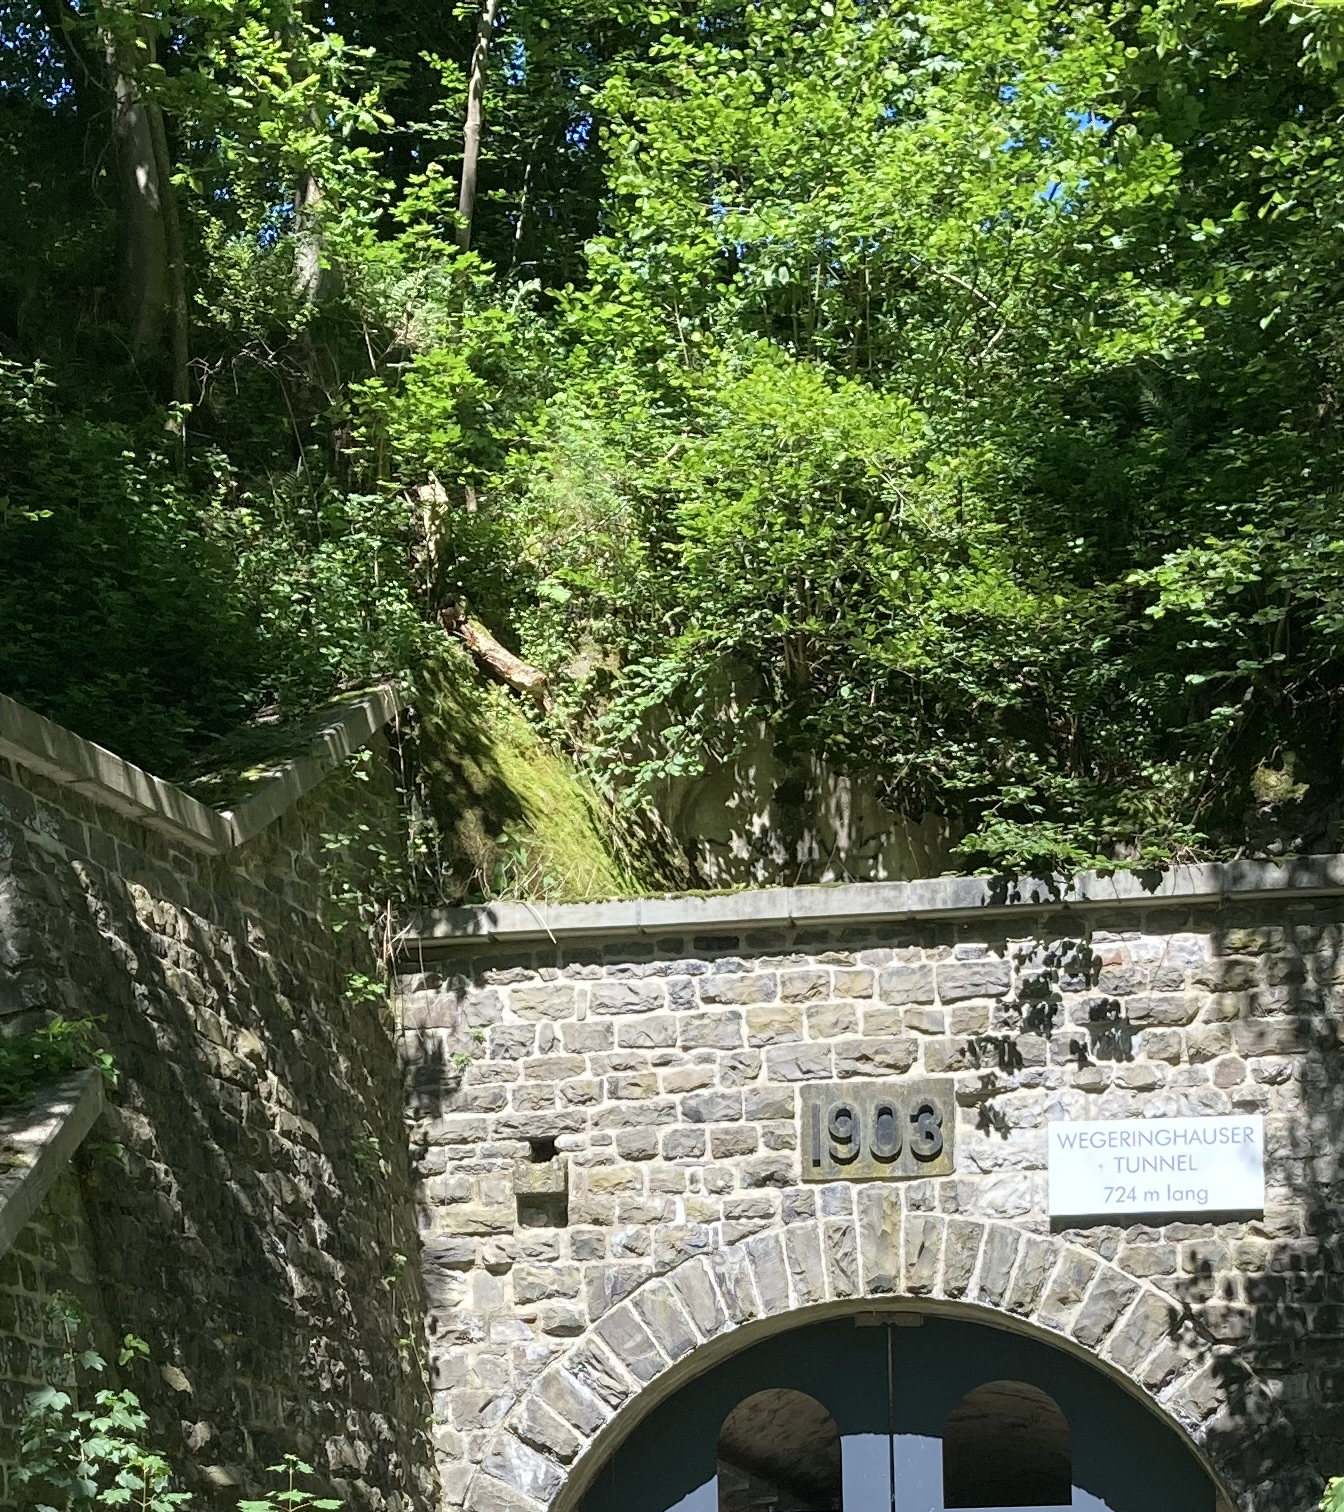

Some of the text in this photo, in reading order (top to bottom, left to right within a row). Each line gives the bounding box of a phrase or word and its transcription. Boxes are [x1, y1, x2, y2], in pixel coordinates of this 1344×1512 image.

[812, 1098, 943, 1167] 1903
[1057, 1126, 1254, 1149] WEGERINGHAUSER
[1113, 1154, 1198, 1174] TUNNEL
[1103, 1183, 1208, 1205] 724 m lang
